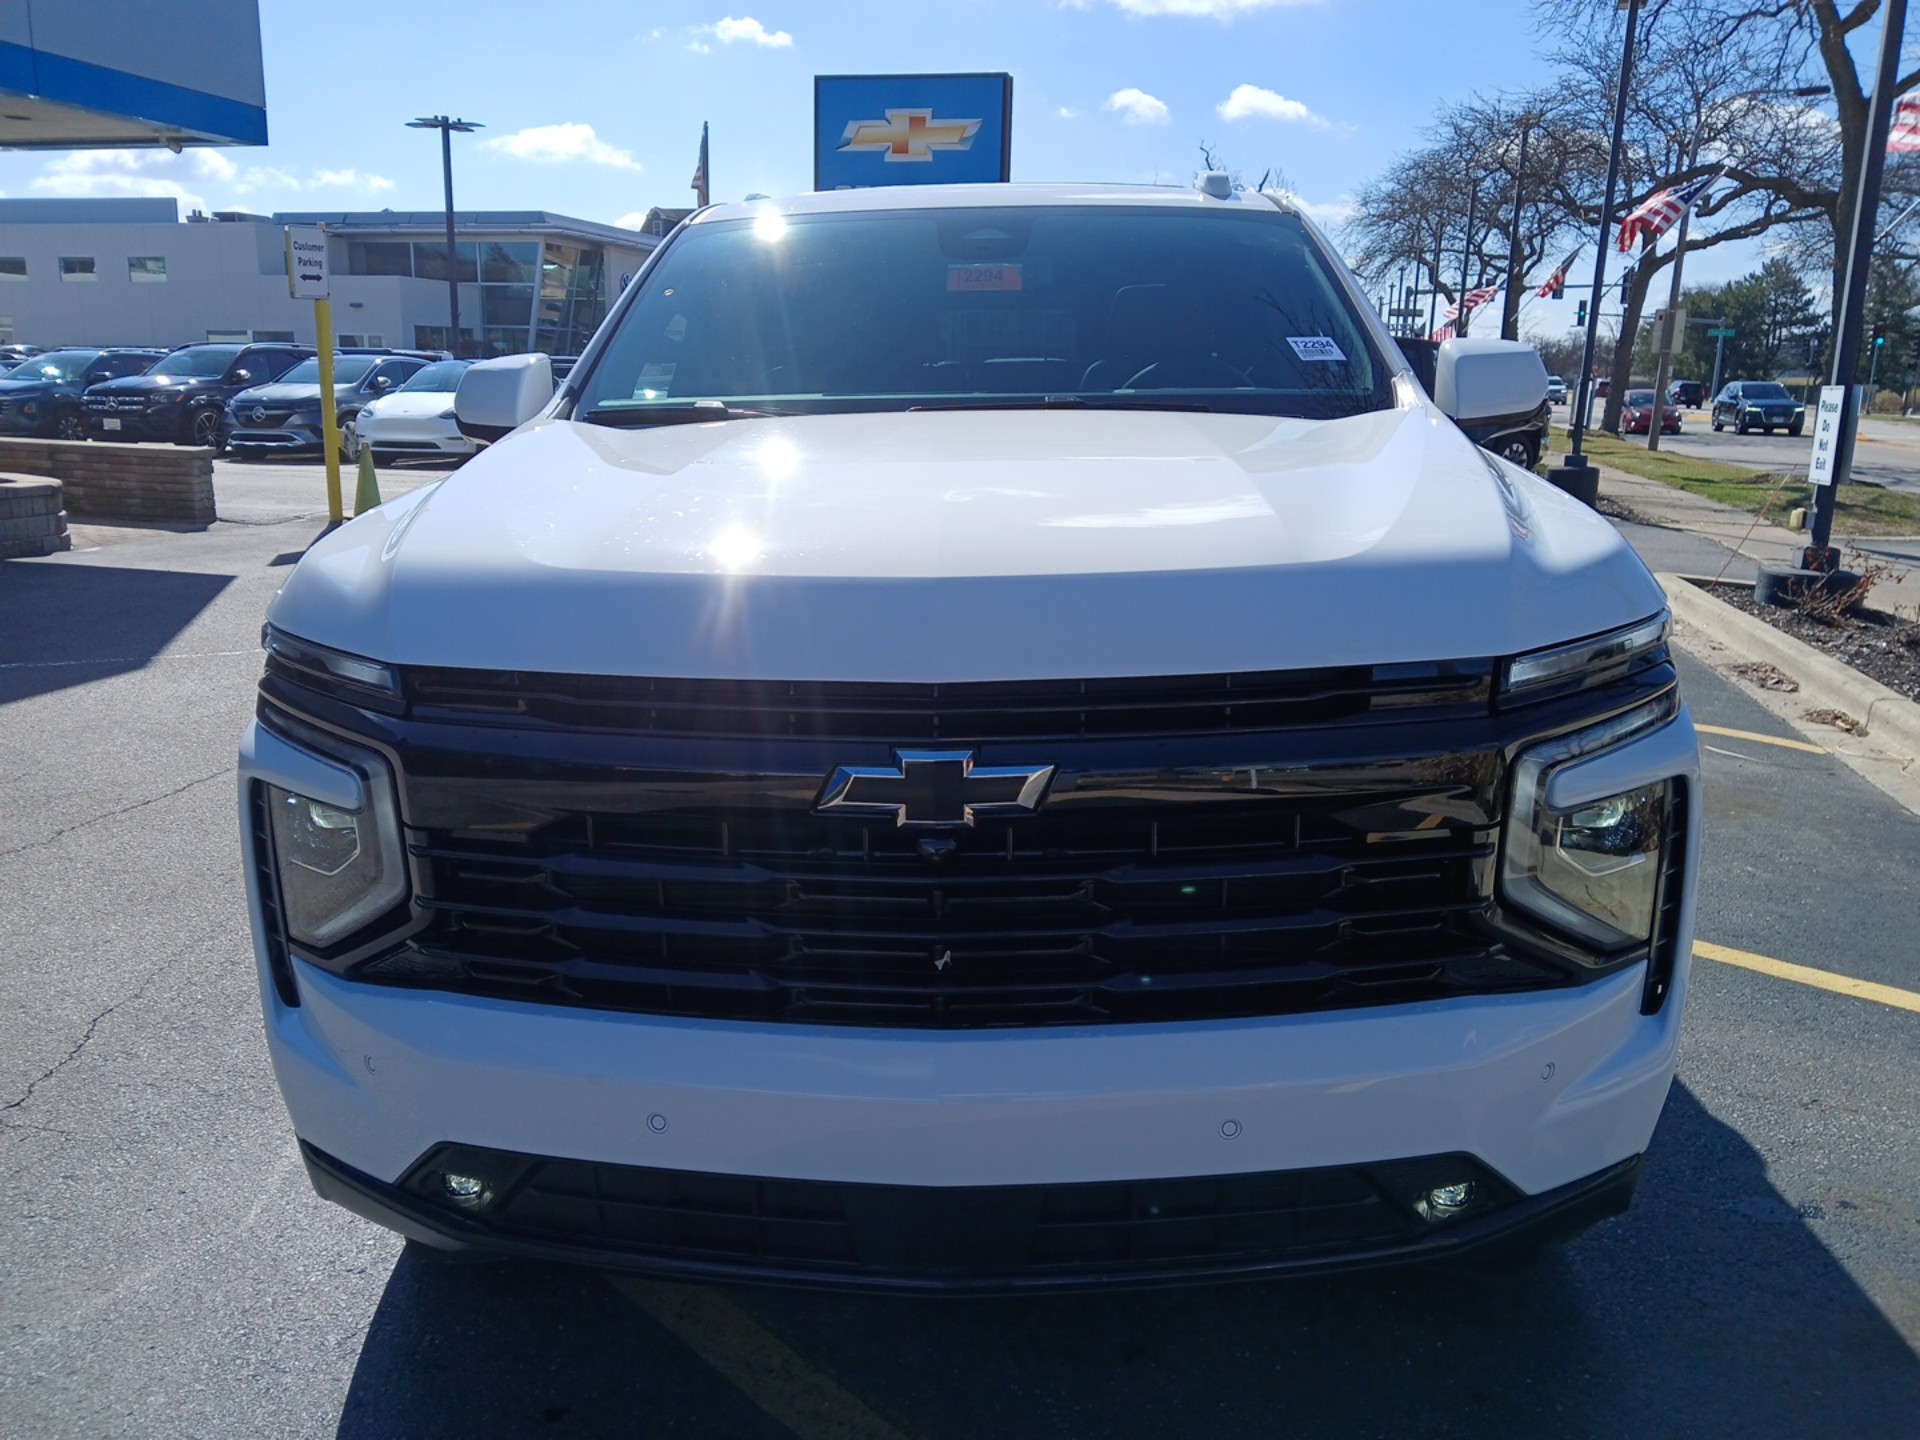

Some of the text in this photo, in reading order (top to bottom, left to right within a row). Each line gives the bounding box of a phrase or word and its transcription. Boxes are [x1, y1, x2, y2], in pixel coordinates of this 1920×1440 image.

[293, 241, 324, 252] Customer
[298, 257, 323, 270] Parking
[1291, 340, 1334, 349] T2294
[1821, 400, 1839, 413] Please
[1822, 419, 1831, 433] Do
[1819, 438, 1829, 451] Not
[1815, 457, 1826, 470] Exit
